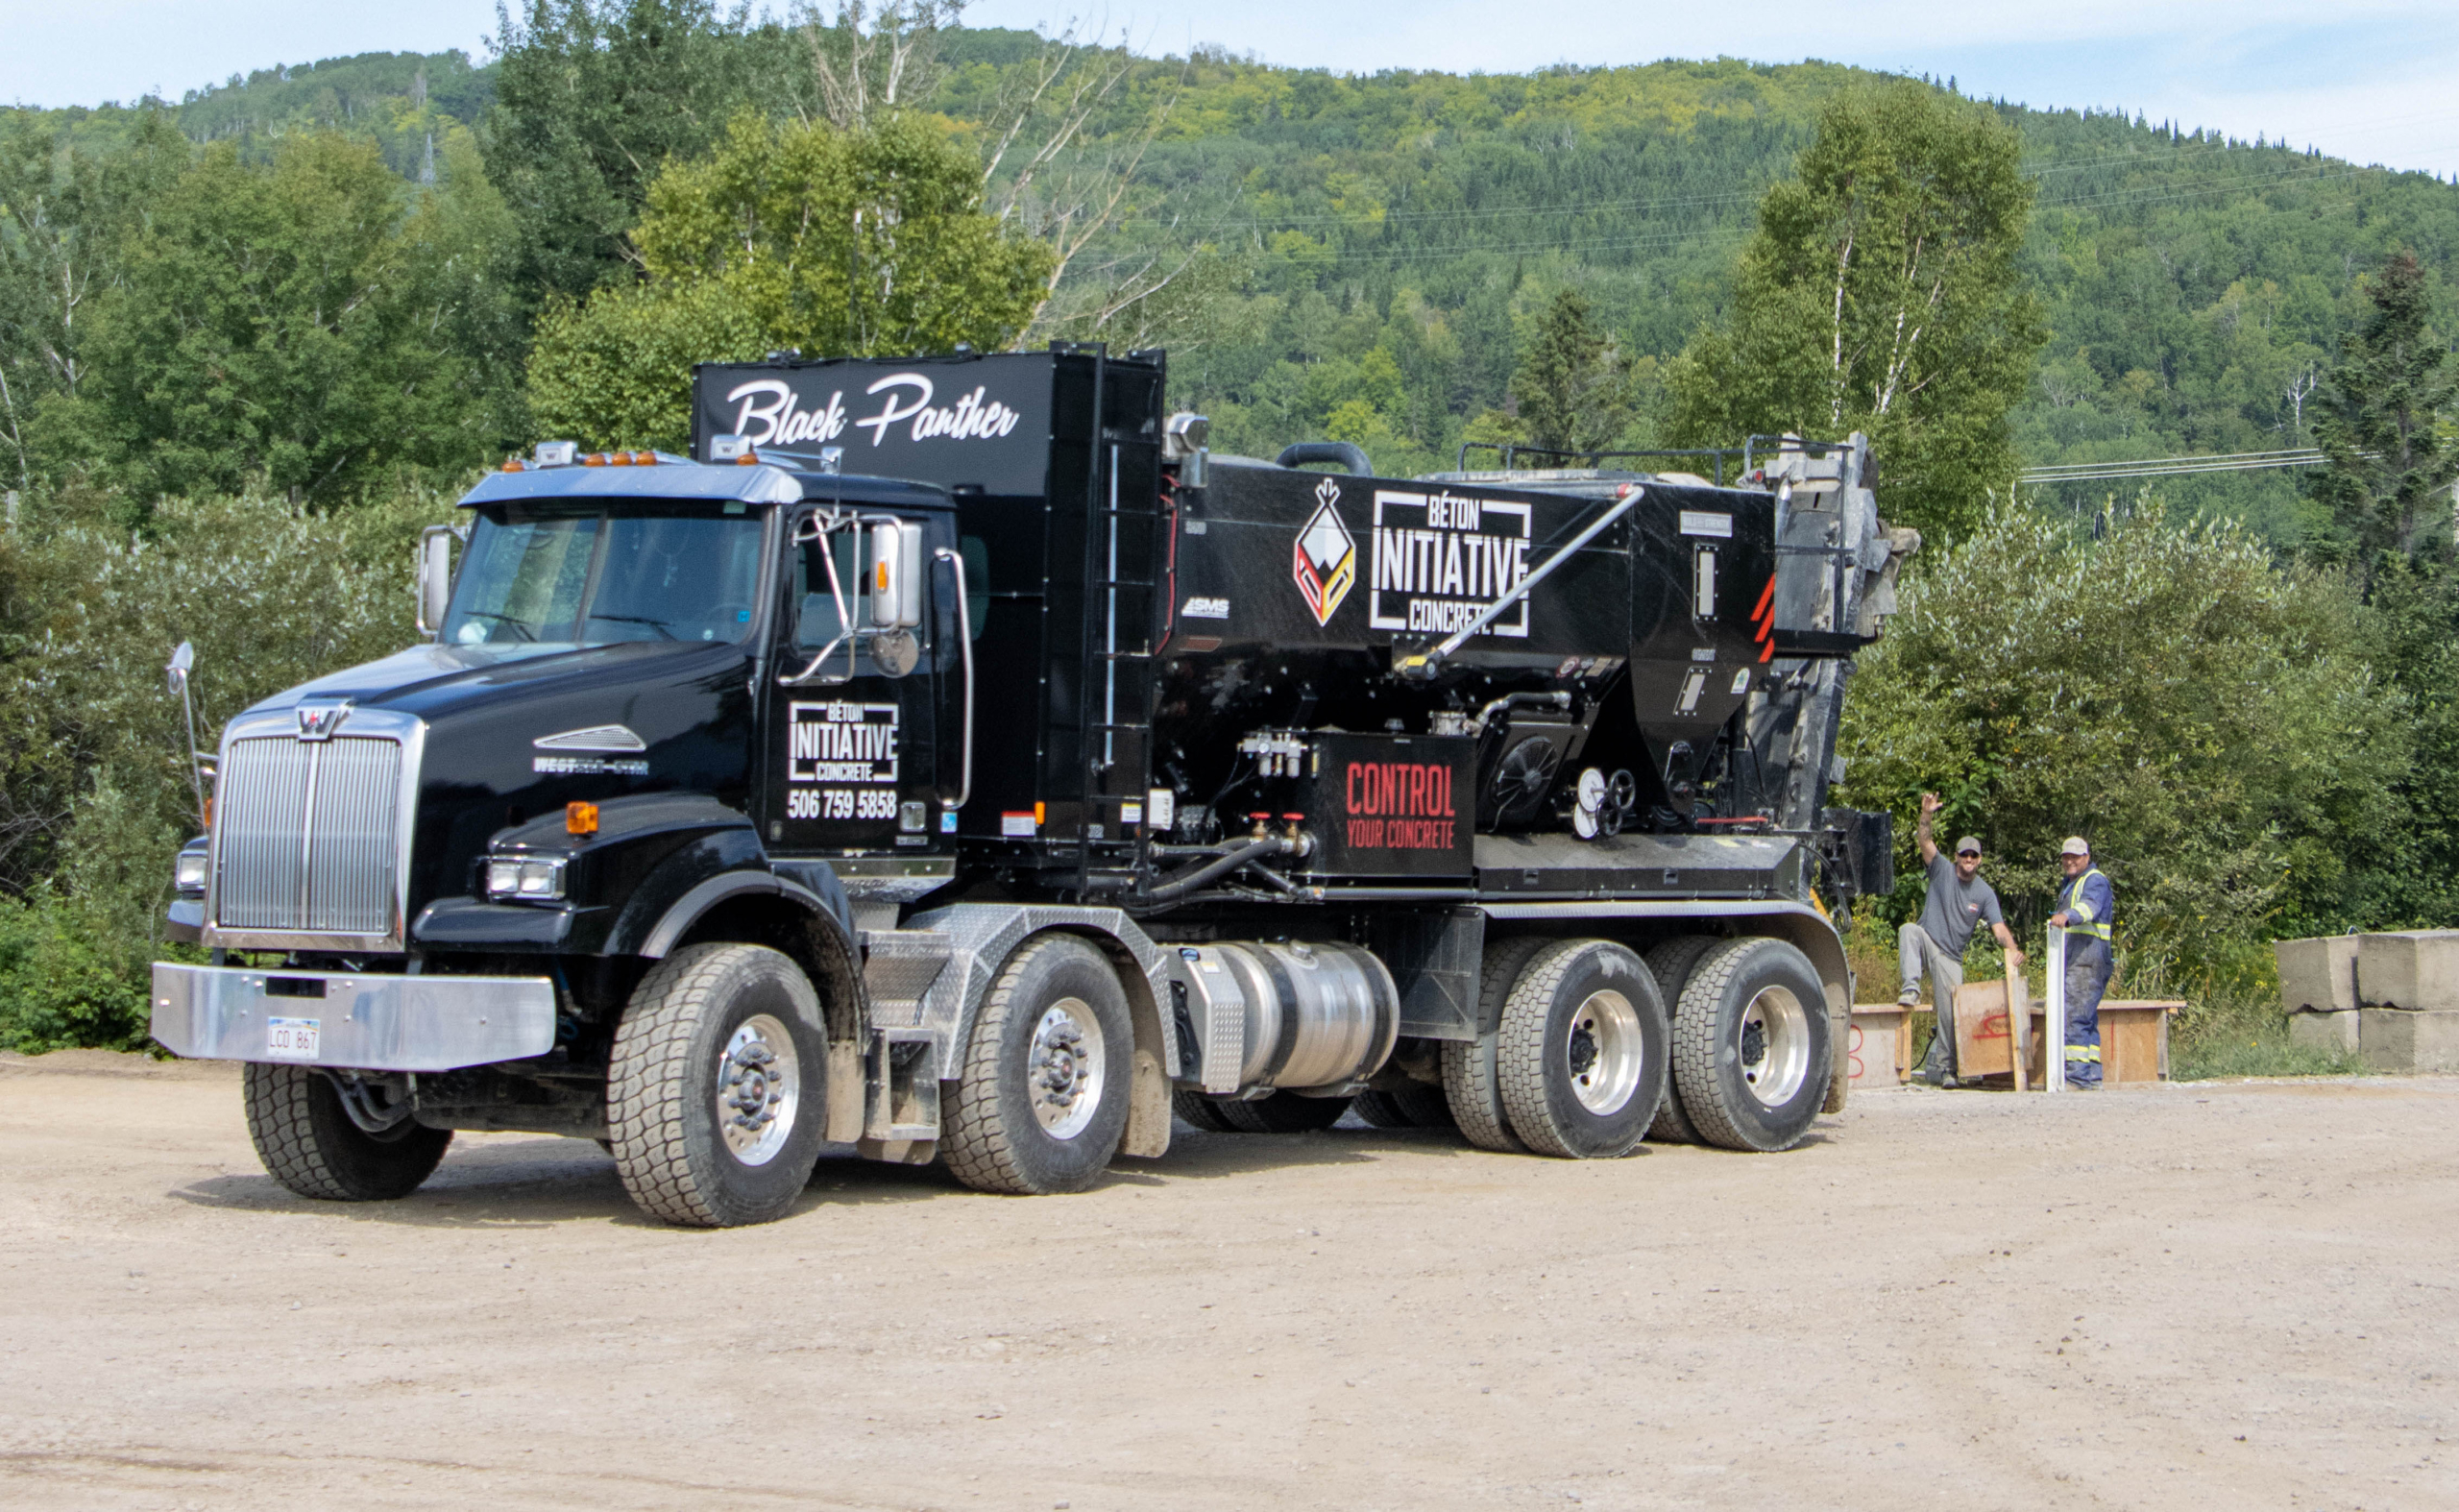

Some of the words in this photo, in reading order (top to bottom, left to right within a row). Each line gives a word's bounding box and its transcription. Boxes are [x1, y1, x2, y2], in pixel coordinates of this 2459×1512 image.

[727, 378, 848, 447] Black
[855, 372, 1020, 448] Panther
[1427, 491, 1480, 531] BÉTON
[1371, 527, 1530, 599] INITIATIVE
[1195, 597, 1230, 613] SMS
[827, 698, 864, 722] BÉTON
[790, 722, 899, 760] INITIATIVE
[816, 762, 873, 782] CONCRETE
[788, 789, 821, 819] 506
[823, 789, 854, 819] 759
[857, 790, 897, 819] 5858
[1347, 761, 1455, 817] CONTROL
[1347, 818, 1383, 848] YOUR
[1386, 819, 1455, 849] CONCRETE
[297, 1031, 318, 1051] 867
